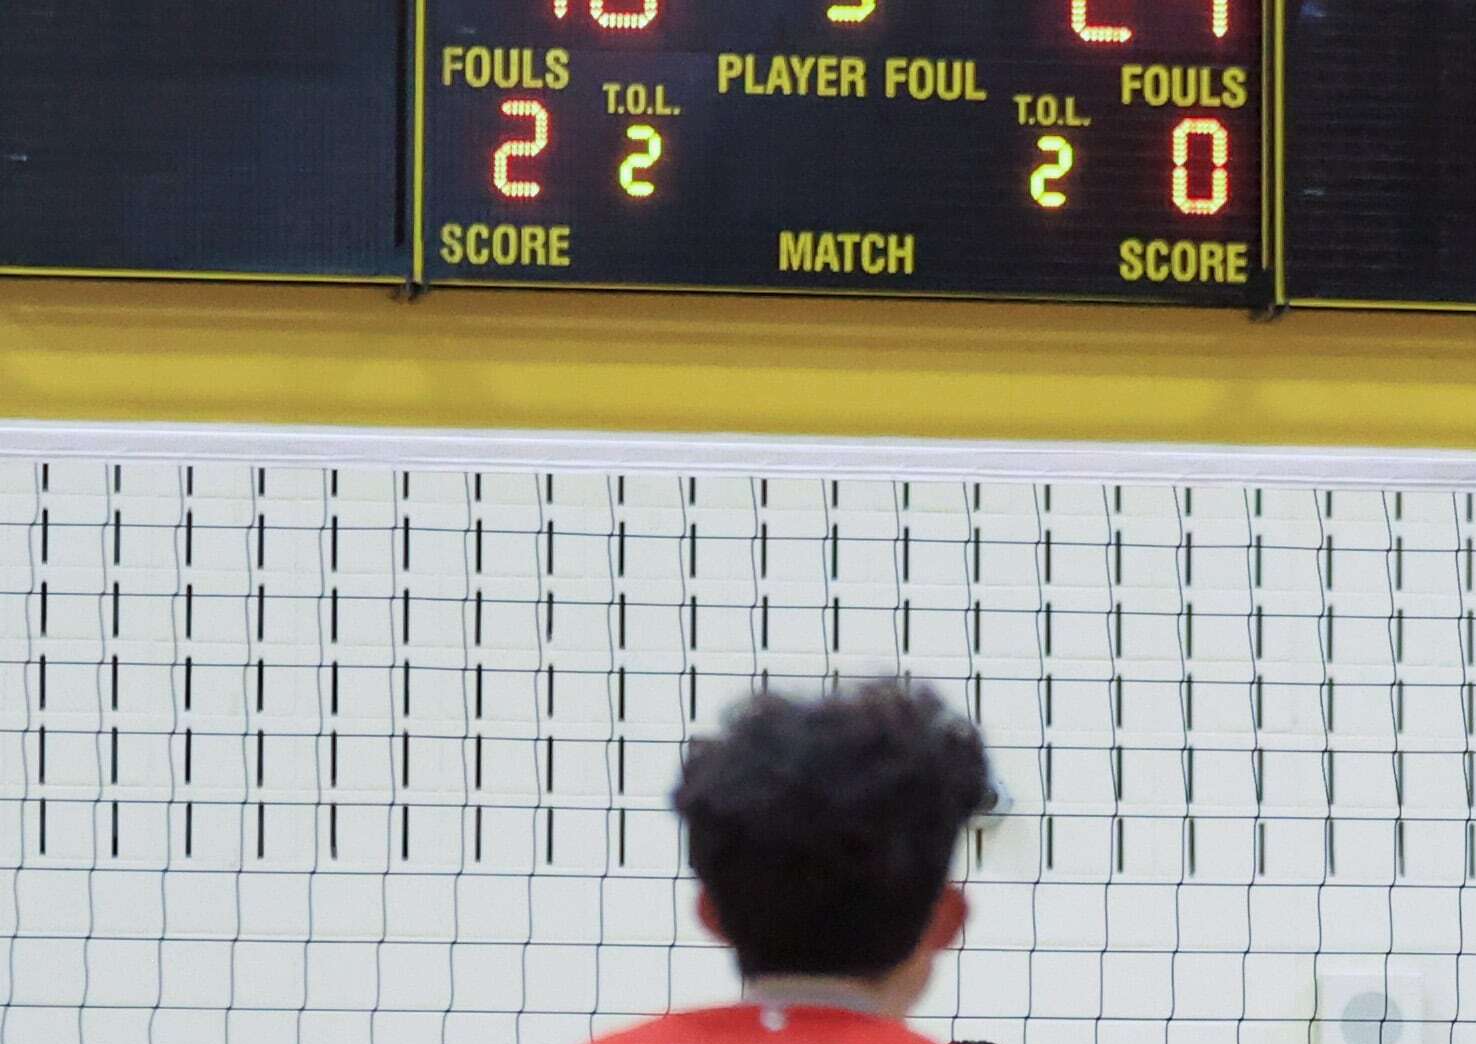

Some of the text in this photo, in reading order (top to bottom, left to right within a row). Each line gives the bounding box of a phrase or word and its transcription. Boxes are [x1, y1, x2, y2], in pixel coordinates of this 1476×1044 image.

[442, 47, 570, 90] FOULS
[718, 53, 987, 101] PLAYER FOUL
[1120, 65, 1248, 109] FOULS
[603, 83, 680, 116] T.O.L.
[1013, 94, 1091, 127] T.O.L.
[494, 100, 548, 198] 2
[619, 124, 662, 197] 2
[1172, 118, 1228, 215] 0
[1030, 135, 1073, 208] 2
[440, 223, 570, 267] SCORE
[779, 230, 915, 275] MATCH
[1119, 240, 1248, 284] SCORE
